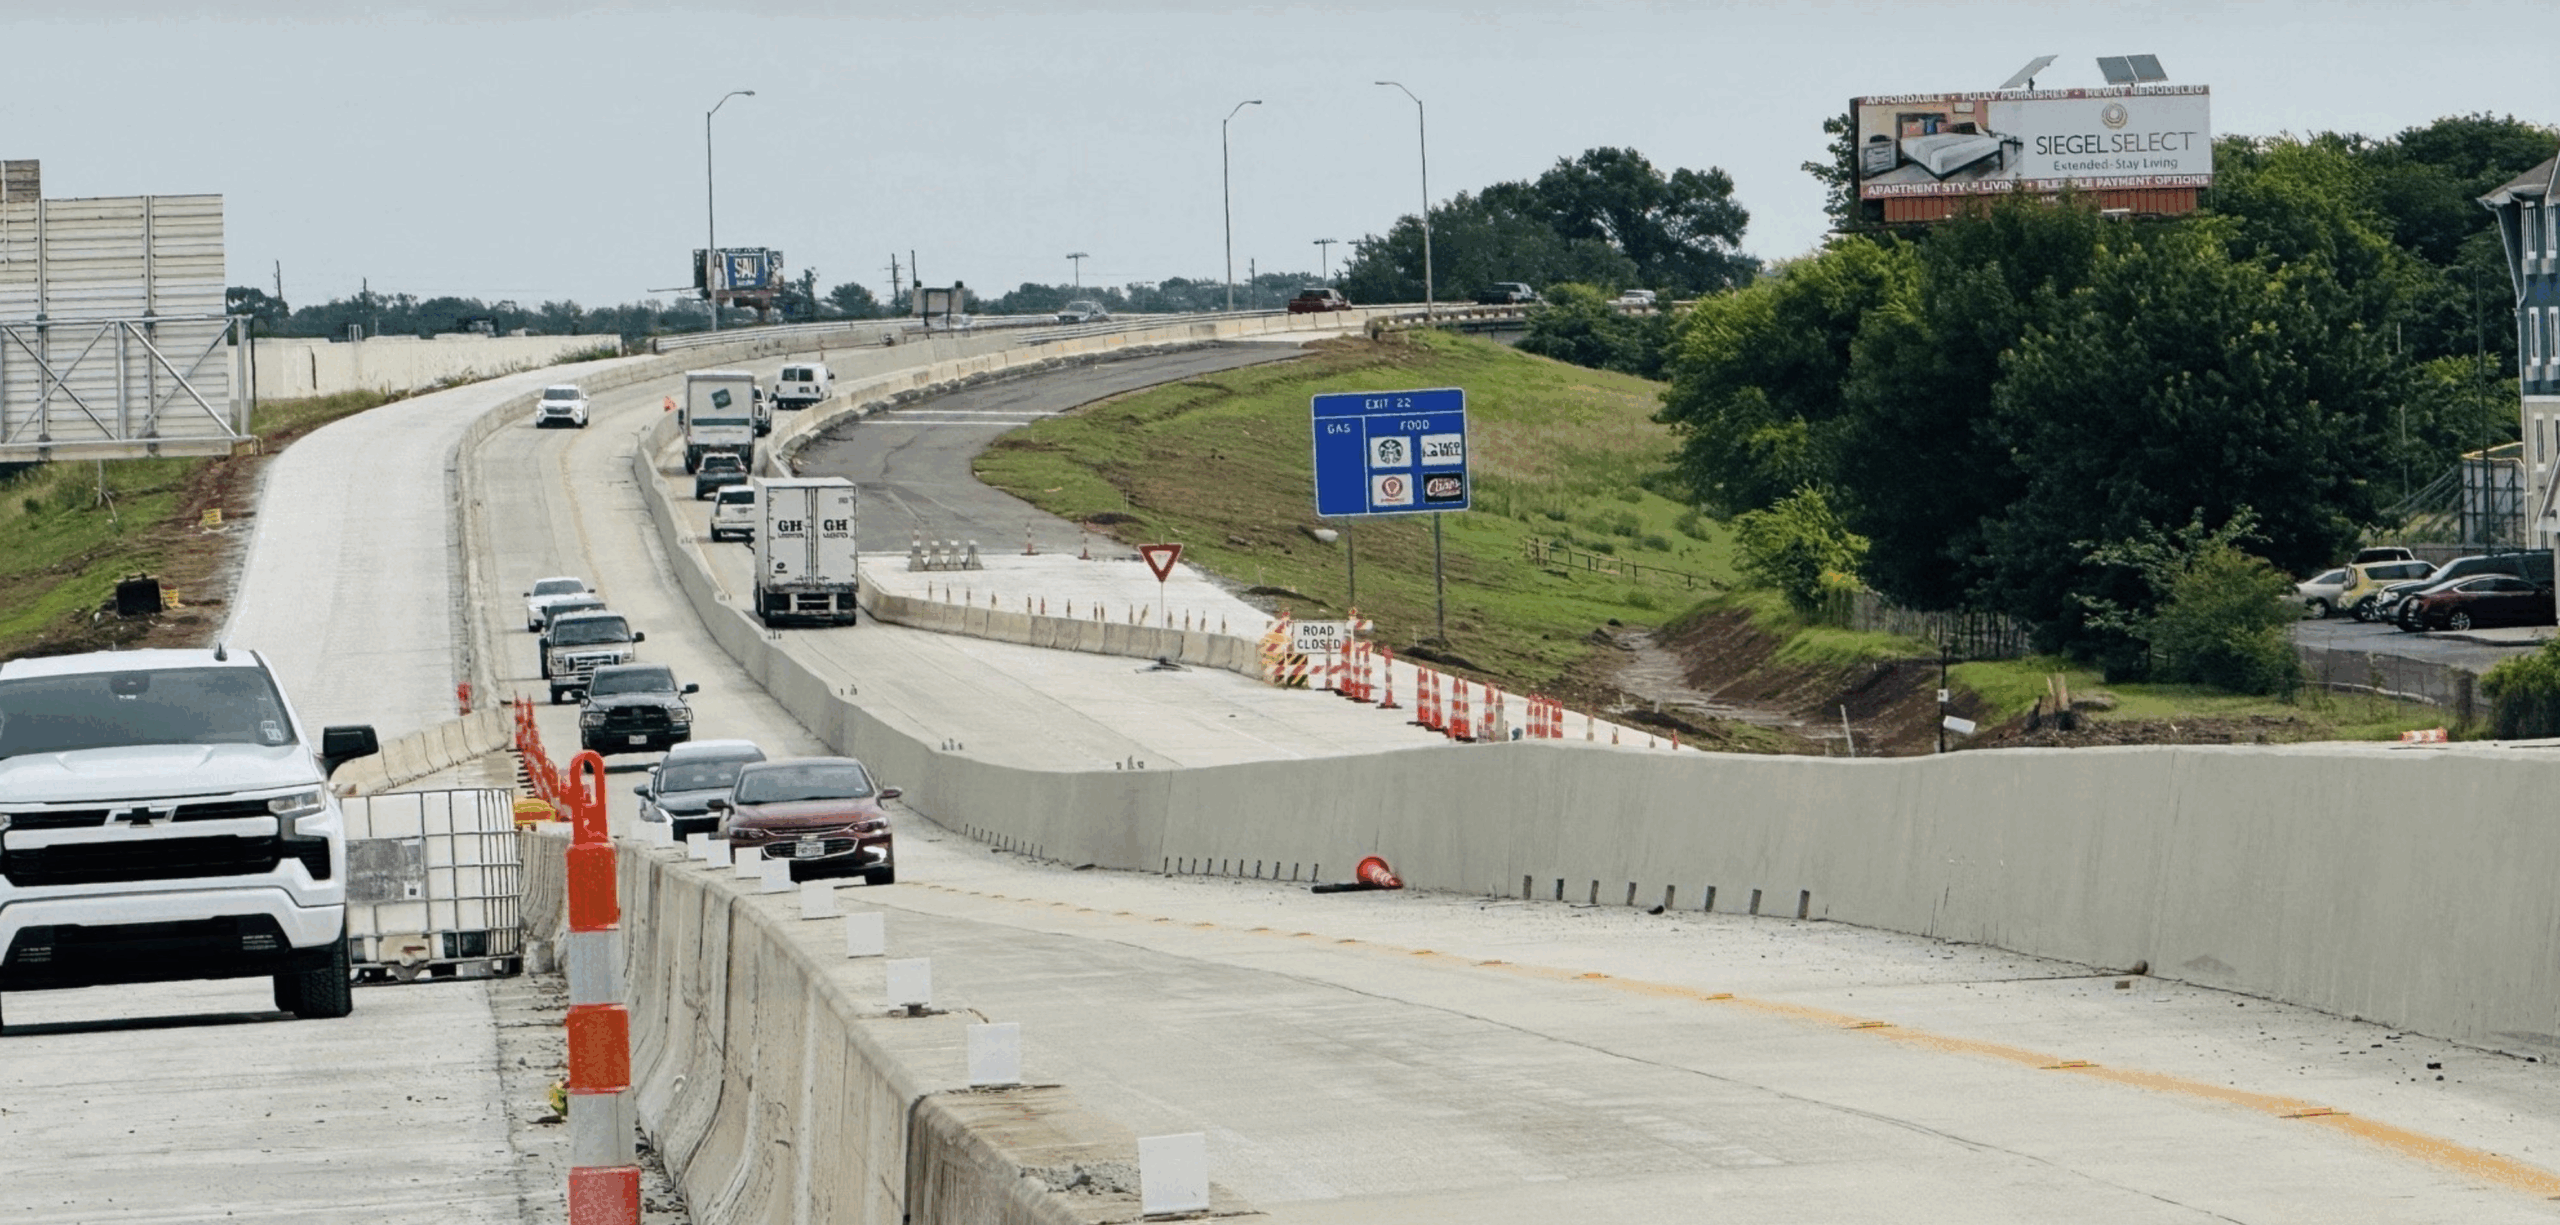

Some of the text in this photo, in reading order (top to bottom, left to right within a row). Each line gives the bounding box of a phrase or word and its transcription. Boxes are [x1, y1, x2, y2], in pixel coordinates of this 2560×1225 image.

[1961, 91, 1996, 101] FULLY
[1999, 88, 2069, 100] FURNISHED
[2085, 87, 2126, 98] NEWLY
[2036, 131, 2198, 155] SIEGEL SELECT
[2143, 157, 2178, 169] Living
[1868, 182, 1940, 195] APARTMENT
[1982, 180, 2018, 191] LIVIN
[2096, 176, 2150, 188] PAYMENT
[2155, 175, 2209, 185] OPTIONS
[1365, 397, 1412, 410] EXIT 22
[1327, 423, 1351, 434] GAS
[1400, 419, 1430, 431] FOOD
[1438, 441, 1460, 450] TACO
[778, 520, 803, 532] GH
[823, 519, 848, 531] GH
[1303, 624, 1335, 636] ROAD
